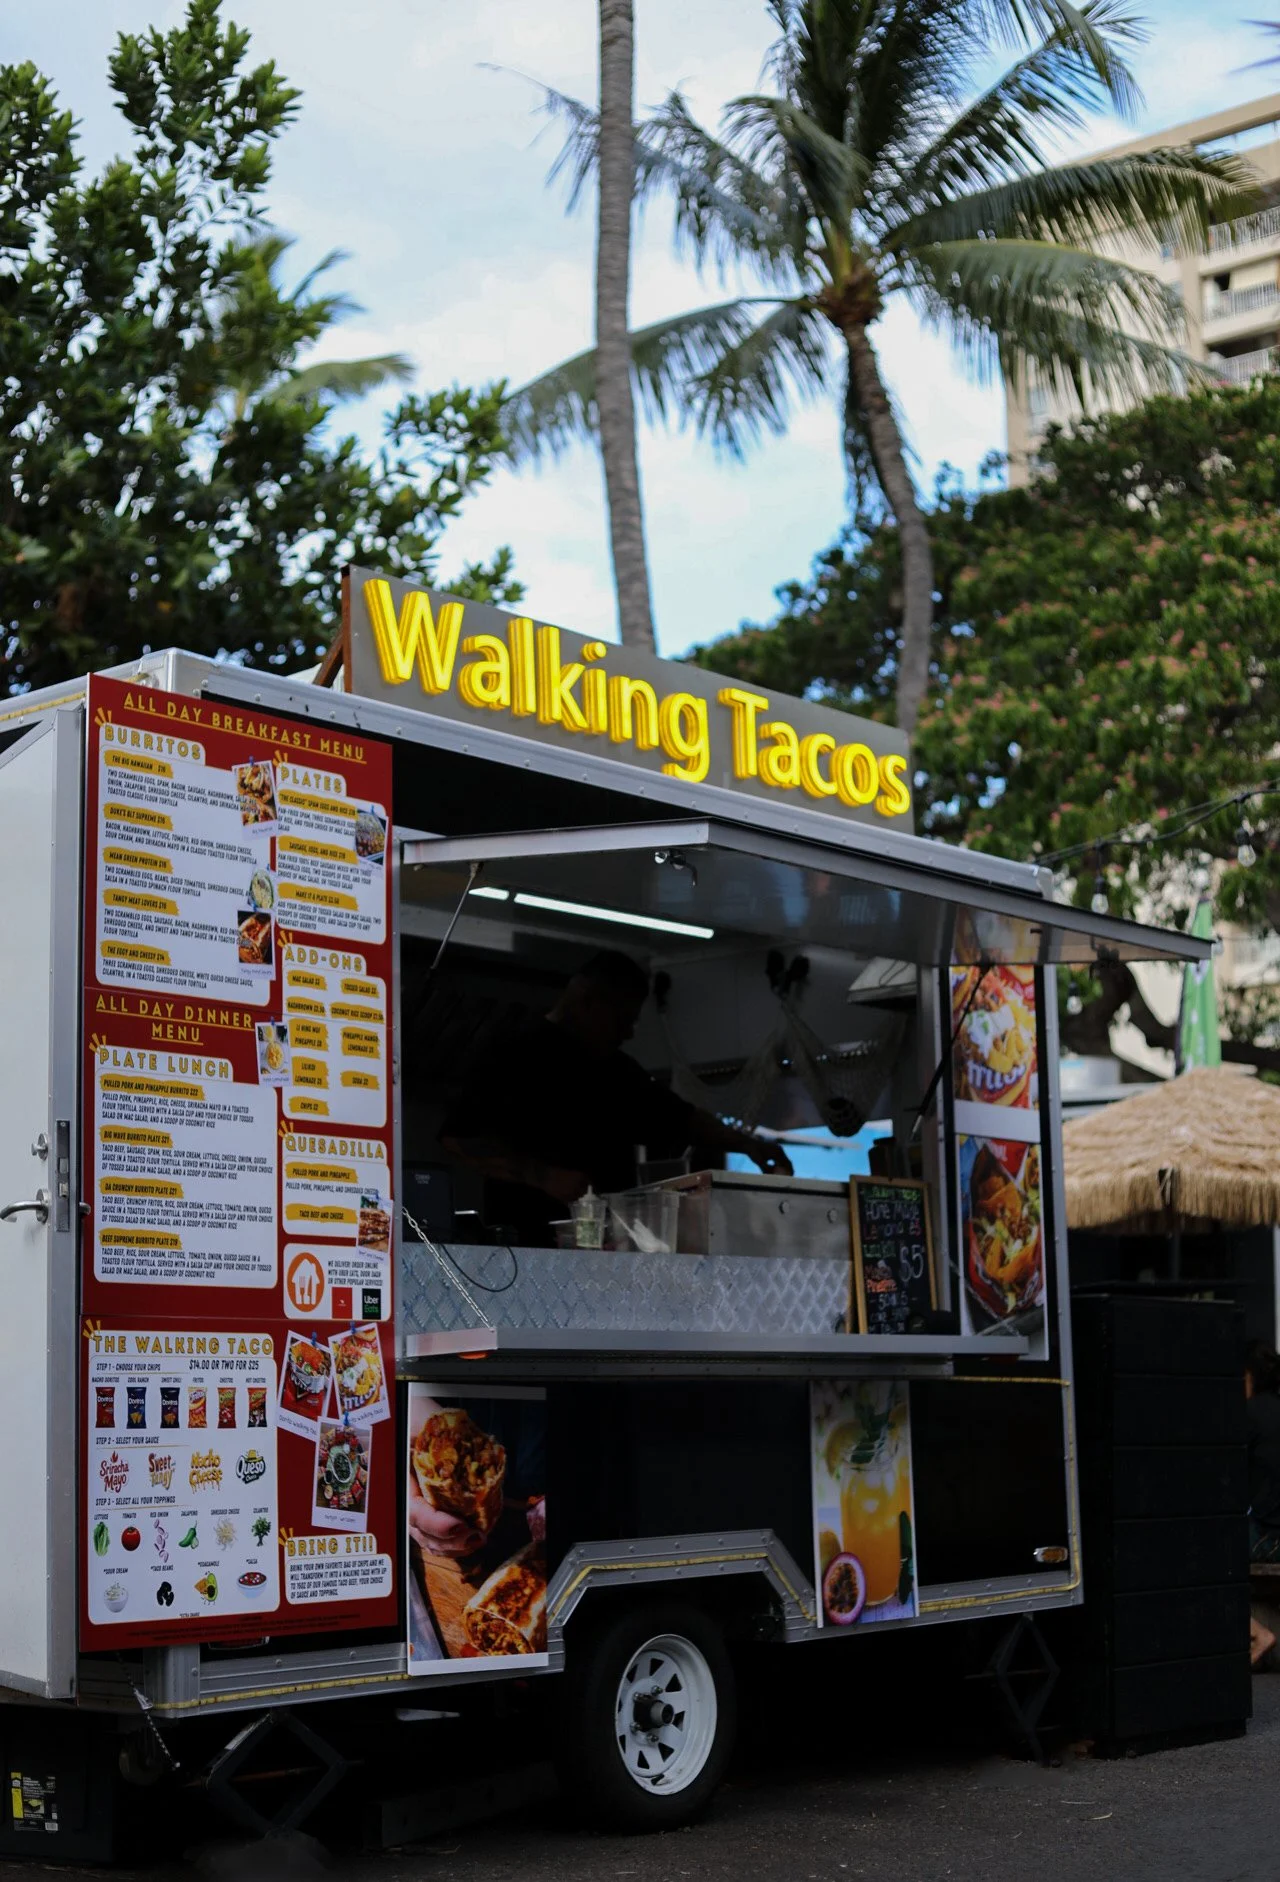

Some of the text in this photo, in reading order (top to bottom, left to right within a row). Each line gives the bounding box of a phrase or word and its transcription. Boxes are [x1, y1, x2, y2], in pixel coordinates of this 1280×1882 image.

[363, 579, 910, 818] Walking Tacos
[124, 692, 364, 760] ALL DAY BREAKFAST MENU
[104, 726, 200, 759] BURRITOS
[281, 766, 342, 793] PLATES
[285, 946, 362, 972] ADD-ONS
[96, 994, 252, 1028] ALL DAY DINNER
[152, 1023, 200, 1041] MENU
[100, 1048, 228, 1078] PLATE LUNCH
[104, 1079, 120, 1088] PULLED
[121, 1082, 133, 1090] PORK
[134, 1083, 144, 1091] AND
[145, 1084, 169, 1094] PINEAPPLE
[169, 1087, 189, 1096] BURRITO
[114, 1131, 126, 1139] WAVE
[127, 1132, 146, 1141] BURRITO
[285, 1136, 384, 1159] QUESADILLA
[113, 1184, 134, 1192] CRUNCHY
[135, 1185, 154, 1193] BURRITO
[155, 1186, 168, 1195] PLATE
[114, 1236, 135, 1244] SUPREME
[136, 1237, 155, 1245] BURRITO
[156, 1238, 169, 1246] PLATE
[93, 1336, 273, 1355] THE WALKING TACO
[189, 1360, 259, 1370] $14.00 OR TWO FOR $25
[149, 1453, 171, 1472] Sweet
[191, 1448, 221, 1469] Nacho
[236, 1455, 265, 1478] Queso
[100, 1461, 129, 1476] Sriracha
[189, 1468, 222, 1487] Cheese
[104, 1474, 127, 1493] Mayo
[116, 1497, 131, 1505] SELECT
[154, 1496, 175, 1504] TOPPINGS
[288, 1538, 338, 1557] BRING
